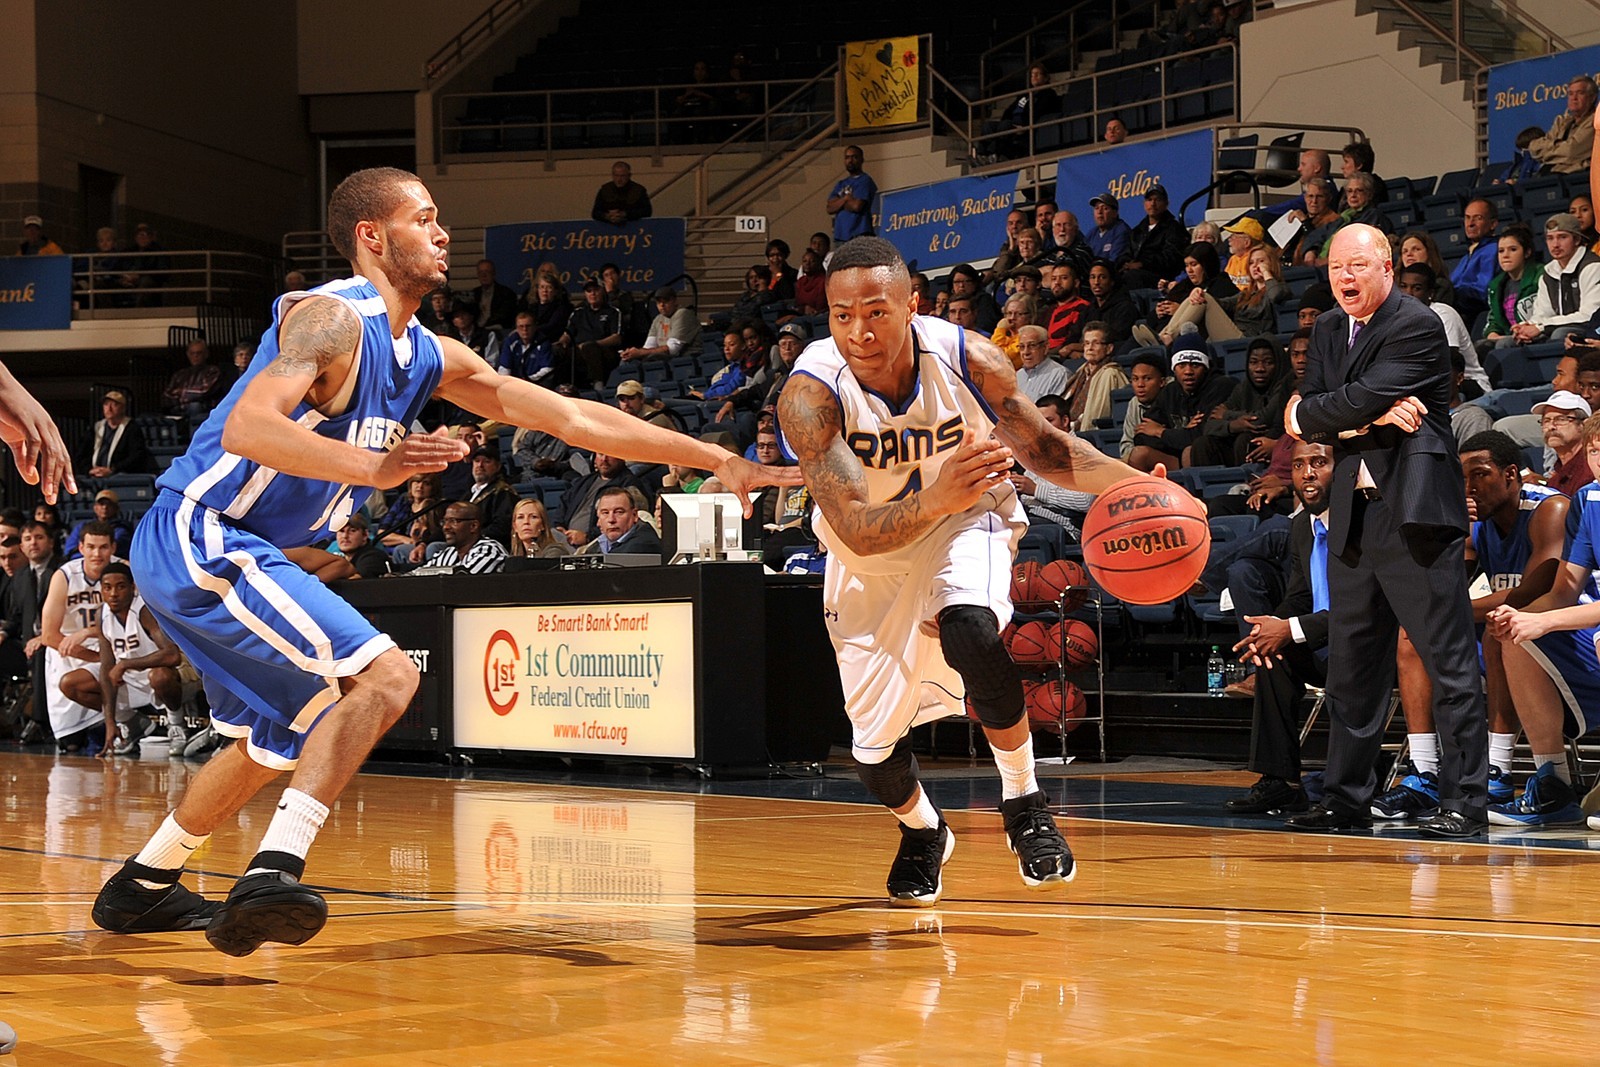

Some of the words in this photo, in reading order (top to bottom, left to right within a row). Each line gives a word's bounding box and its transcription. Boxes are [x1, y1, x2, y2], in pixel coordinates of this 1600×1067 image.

[1495, 87, 1528, 110] Blue
[1533, 83, 1568, 102] Cros
[739, 218, 762, 230] 101
[885, 204, 959, 233] Armstrong,
[961, 189, 1011, 217] Backus
[520, 232, 557, 252] Ric
[563, 227, 653, 255] Henry's
[929, 234, 941, 252] &
[943, 231, 961, 250] Co
[847, 414, 964, 469] RAMS
[1107, 493, 1169, 518] NCAA
[1102, 525, 1188, 556] Wilson
[68, 590, 102, 606] RAM
[537, 614, 549, 632] Be
[551, 613, 585, 632] Smart!
[586, 612, 612, 631] Bank
[613, 612, 649, 631] Smart!
[493, 658, 515, 692] 1st
[525, 644, 548, 677] 1st
[556, 643, 664, 687] Community
[530, 685, 572, 707] Federal
[575, 686, 611, 708] Credit
[614, 687, 650, 709] Union
[553, 720, 628, 746] www.1cfcu.org
